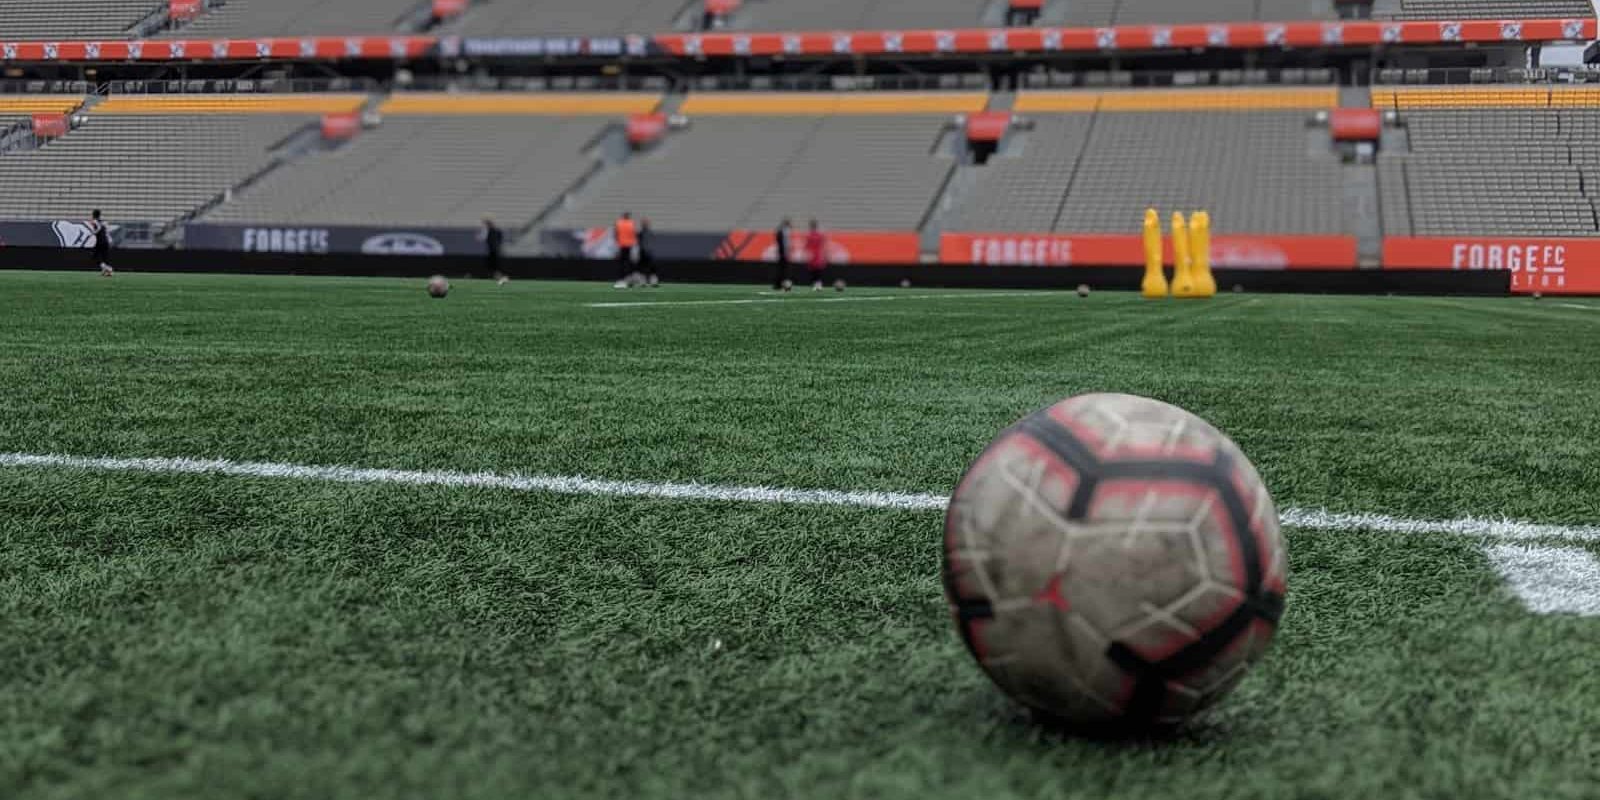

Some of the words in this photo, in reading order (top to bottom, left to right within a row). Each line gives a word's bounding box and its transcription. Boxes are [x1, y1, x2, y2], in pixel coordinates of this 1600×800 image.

[243, 229, 308, 252] FORGE
[972, 239, 1045, 265] FORGE
[1452, 244, 1539, 272] FORGE
[1544, 246, 1565, 265] FC
[1512, 275, 1565, 286] LTON
